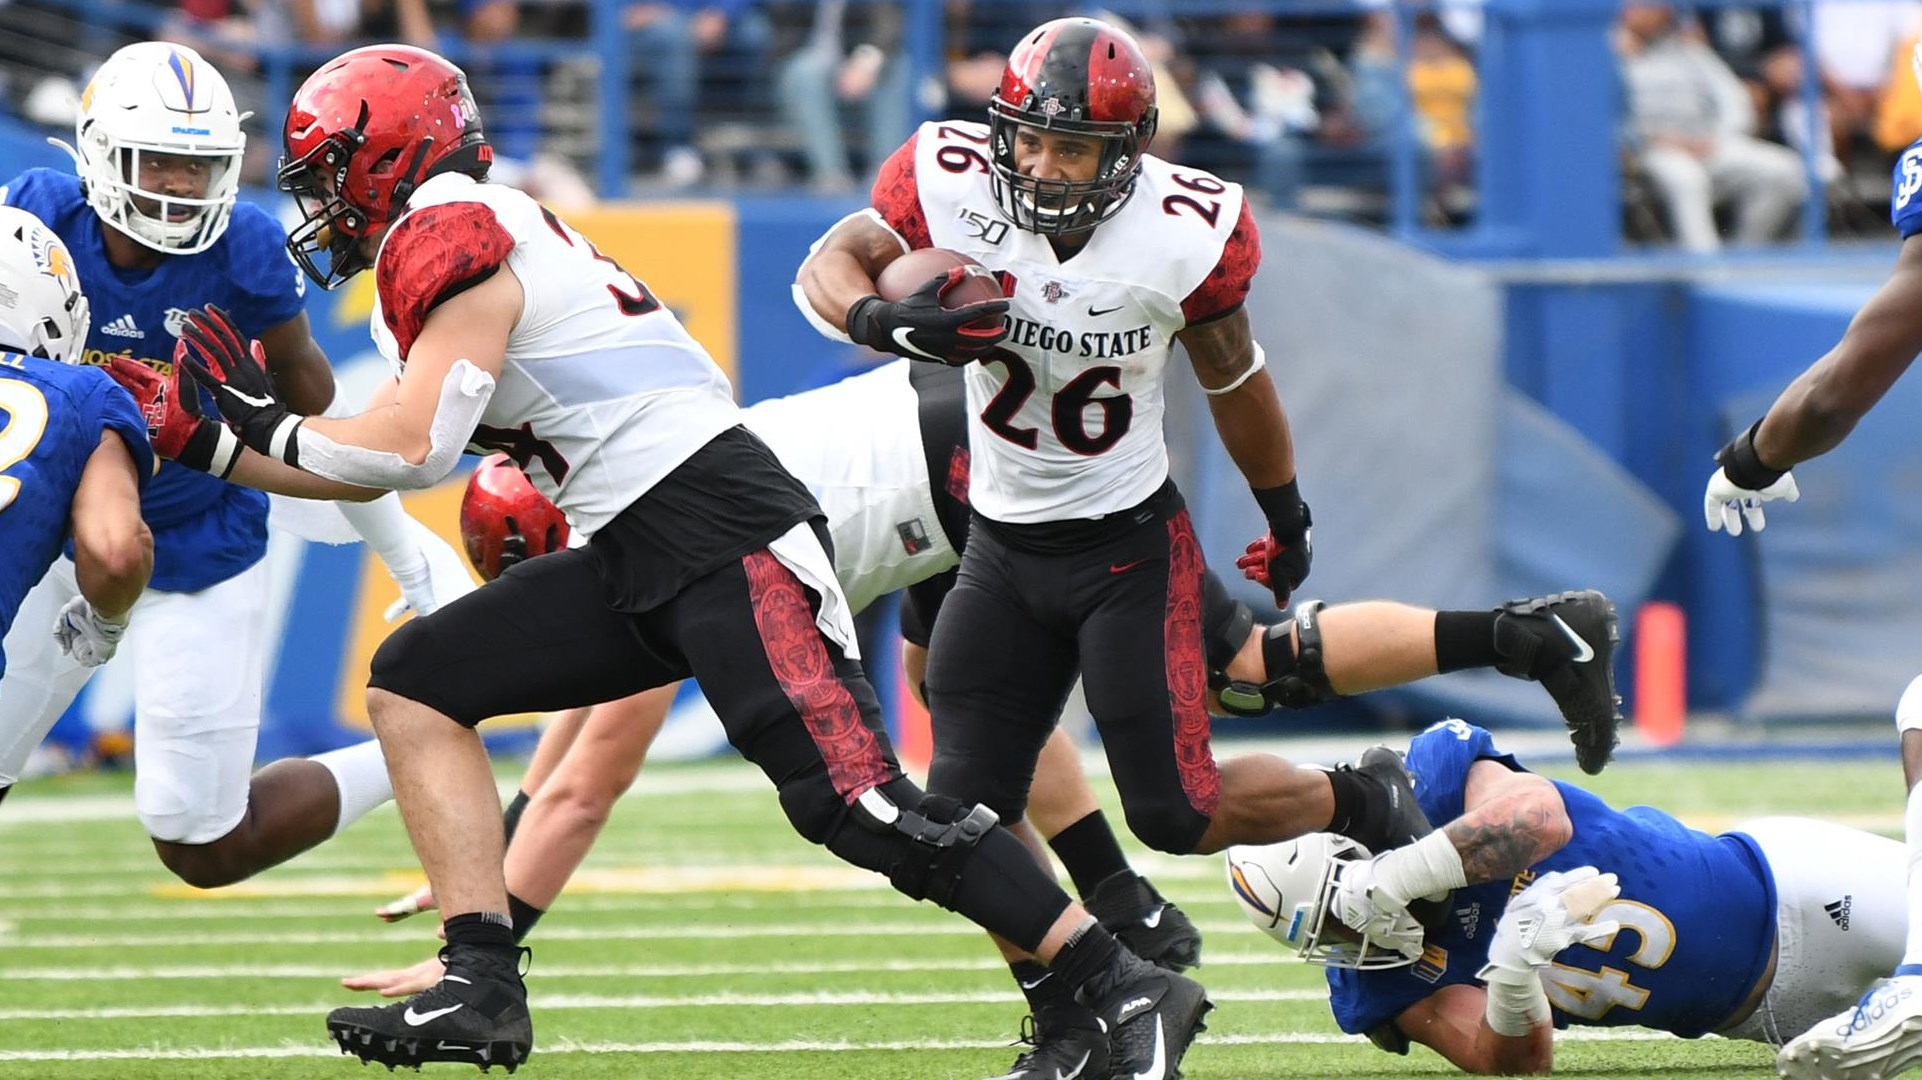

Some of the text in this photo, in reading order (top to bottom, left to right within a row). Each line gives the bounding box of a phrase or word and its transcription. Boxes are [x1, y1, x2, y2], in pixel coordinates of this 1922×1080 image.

[1161, 173, 1227, 230] 26
[100, 325, 145, 339] adidas
[1078, 324, 1152, 359] STATE
[978, 346, 1134, 457] 26
[1841, 894, 1852, 932] adidas
[1537, 898, 1677, 1021] 45
[1836, 986, 1893, 1043] adidas
